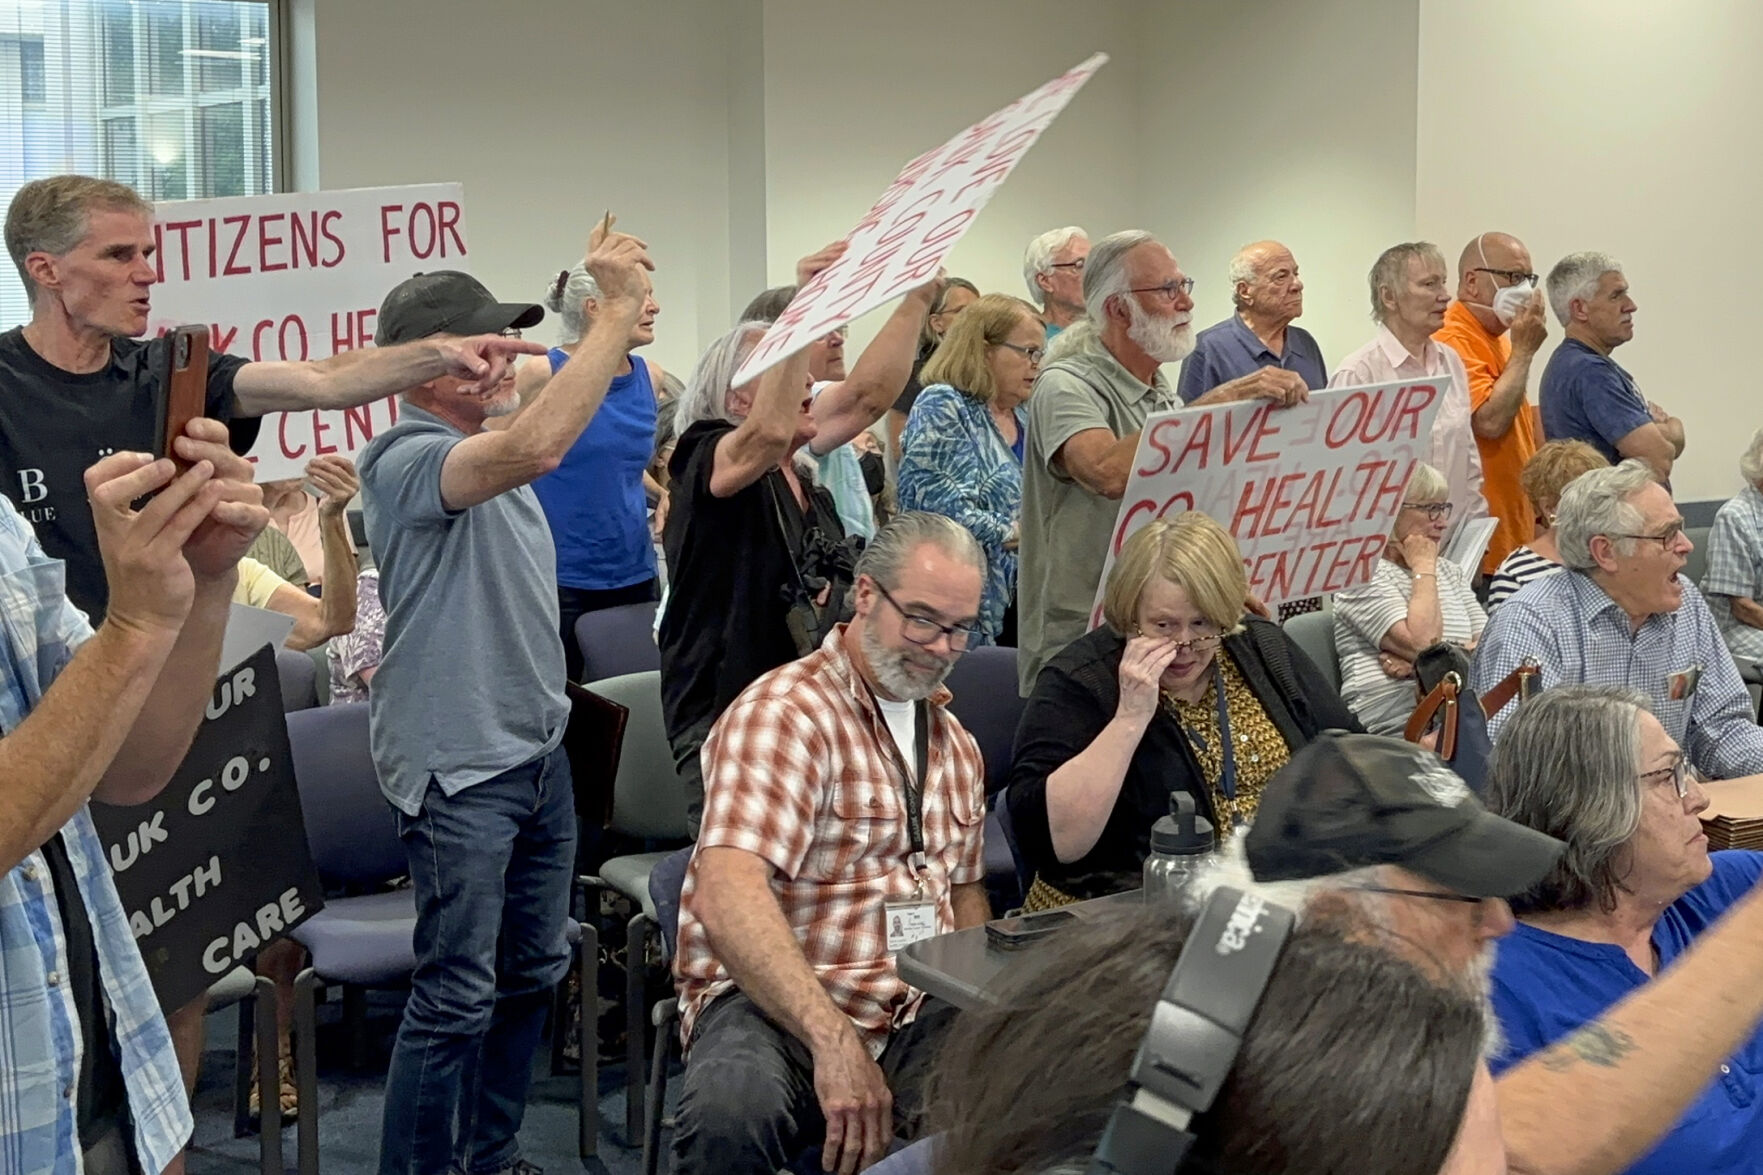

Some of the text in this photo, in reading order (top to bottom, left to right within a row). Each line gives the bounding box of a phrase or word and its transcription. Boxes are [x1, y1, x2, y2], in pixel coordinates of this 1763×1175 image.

[154, 201, 467, 283] ITIZENS FOR
[1137, 403, 1281, 477] SAVE
[1325, 385, 1437, 449] OUR
[1229, 458, 1418, 540] HEALTH
[1242, 533, 1387, 603] ENTER
[205, 667, 256, 721] UR
[110, 756, 271, 873] UK CO.
[130, 855, 222, 940] ALTH
[202, 887, 305, 974] CARE
